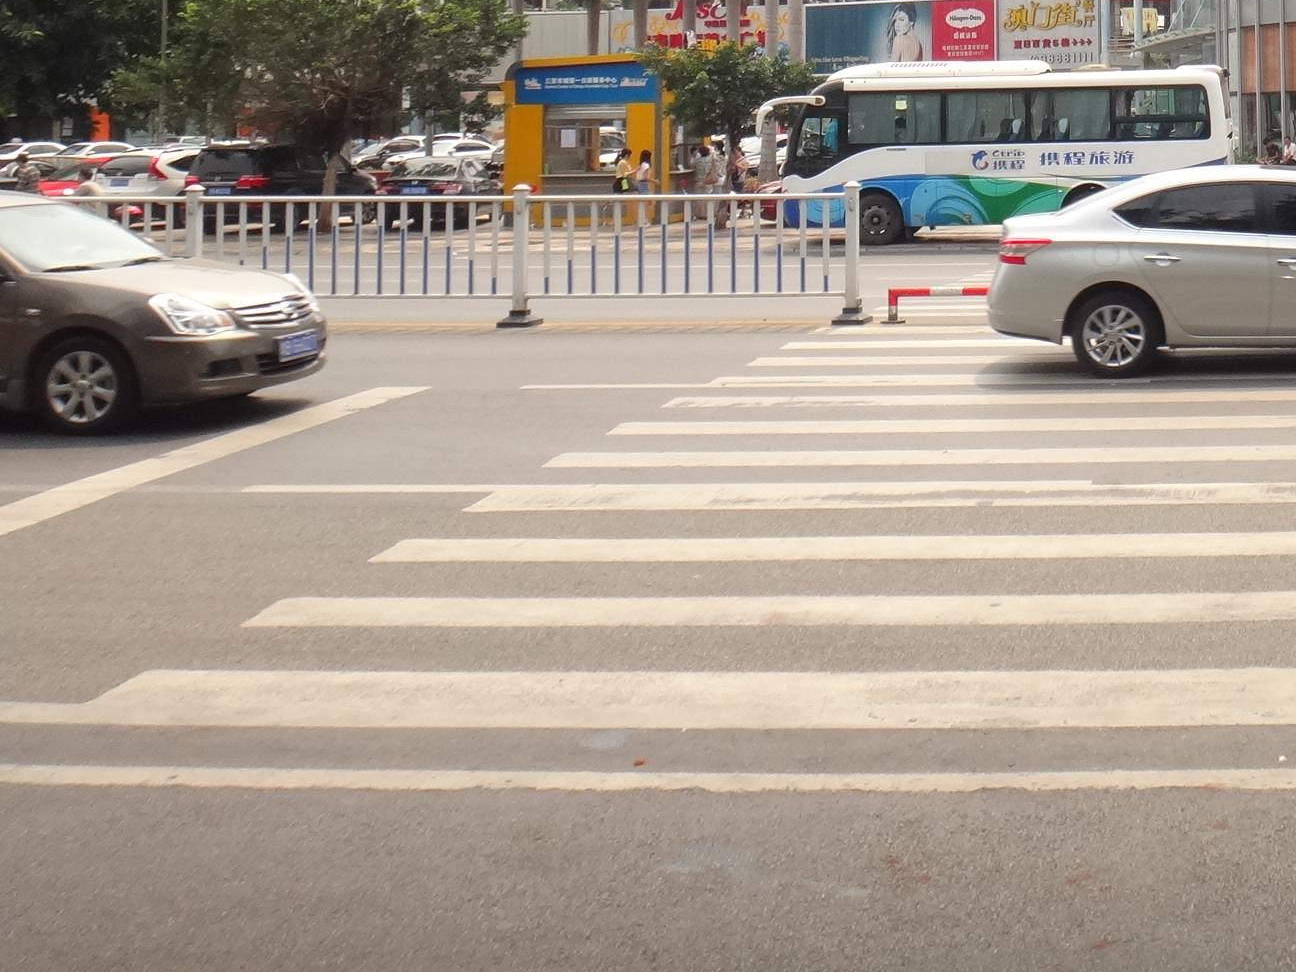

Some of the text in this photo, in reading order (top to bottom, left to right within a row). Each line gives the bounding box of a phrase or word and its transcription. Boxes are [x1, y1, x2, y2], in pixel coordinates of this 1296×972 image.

[1003, 1, 1082, 32] 澳门街
[1039, 151, 1135, 166] 携程旅游
